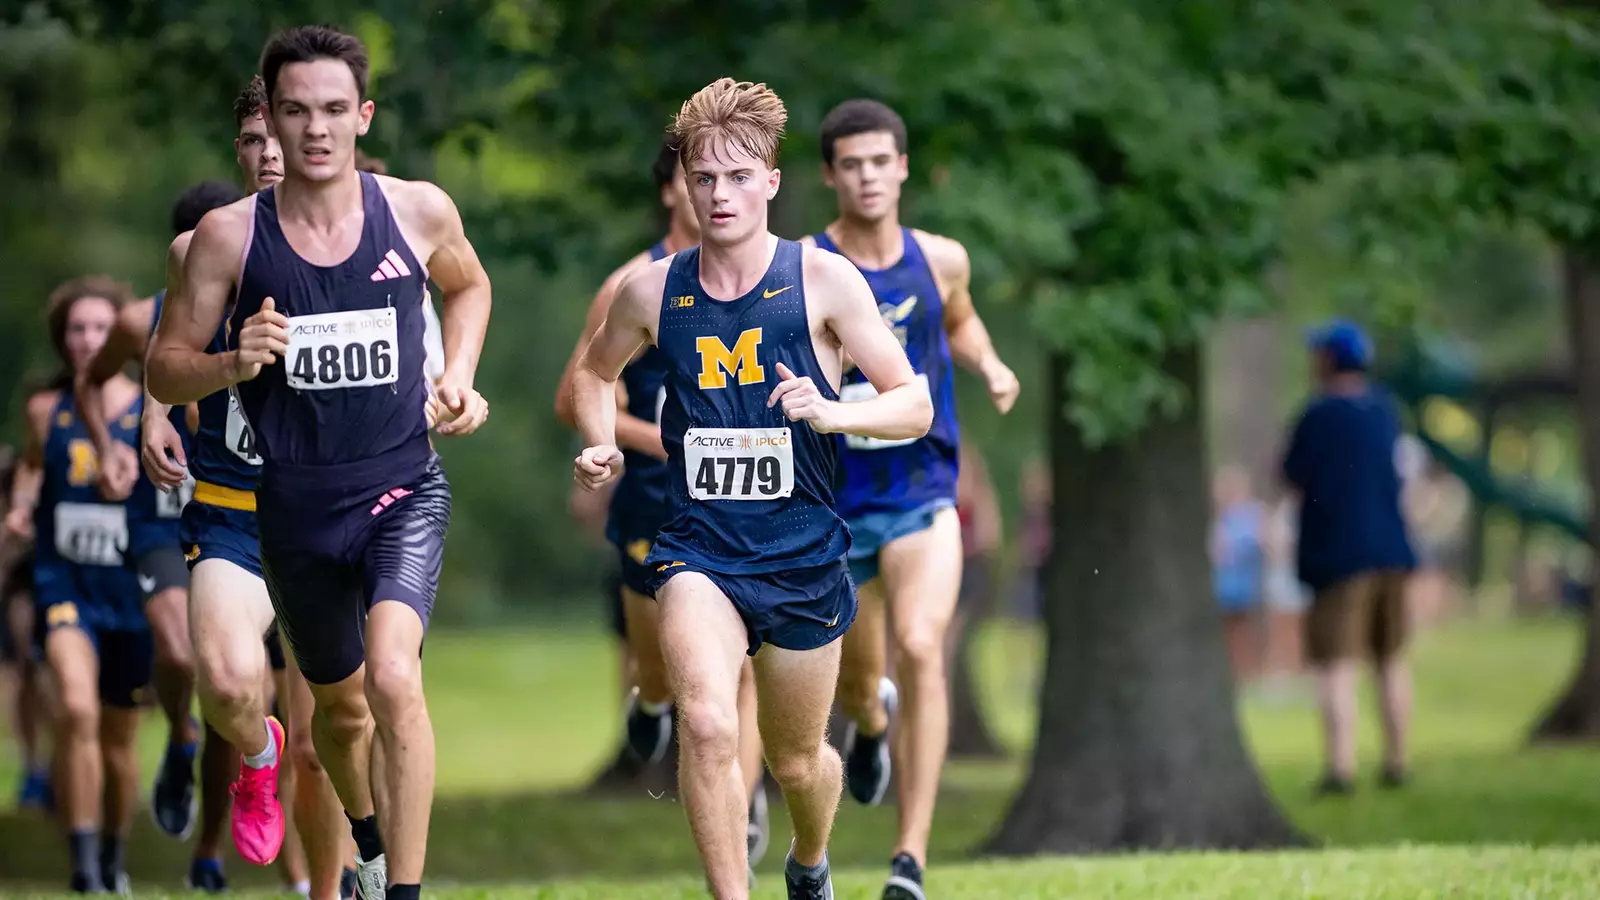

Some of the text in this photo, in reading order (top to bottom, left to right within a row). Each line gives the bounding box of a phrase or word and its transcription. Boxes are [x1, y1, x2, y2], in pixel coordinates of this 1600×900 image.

[291, 323, 338, 336] ACTIVE
[293, 340, 391, 384] 4806
[696, 327, 765, 389] M
[689, 436, 787, 447] ACTIVE IPICO
[695, 456, 782, 495] 4779
